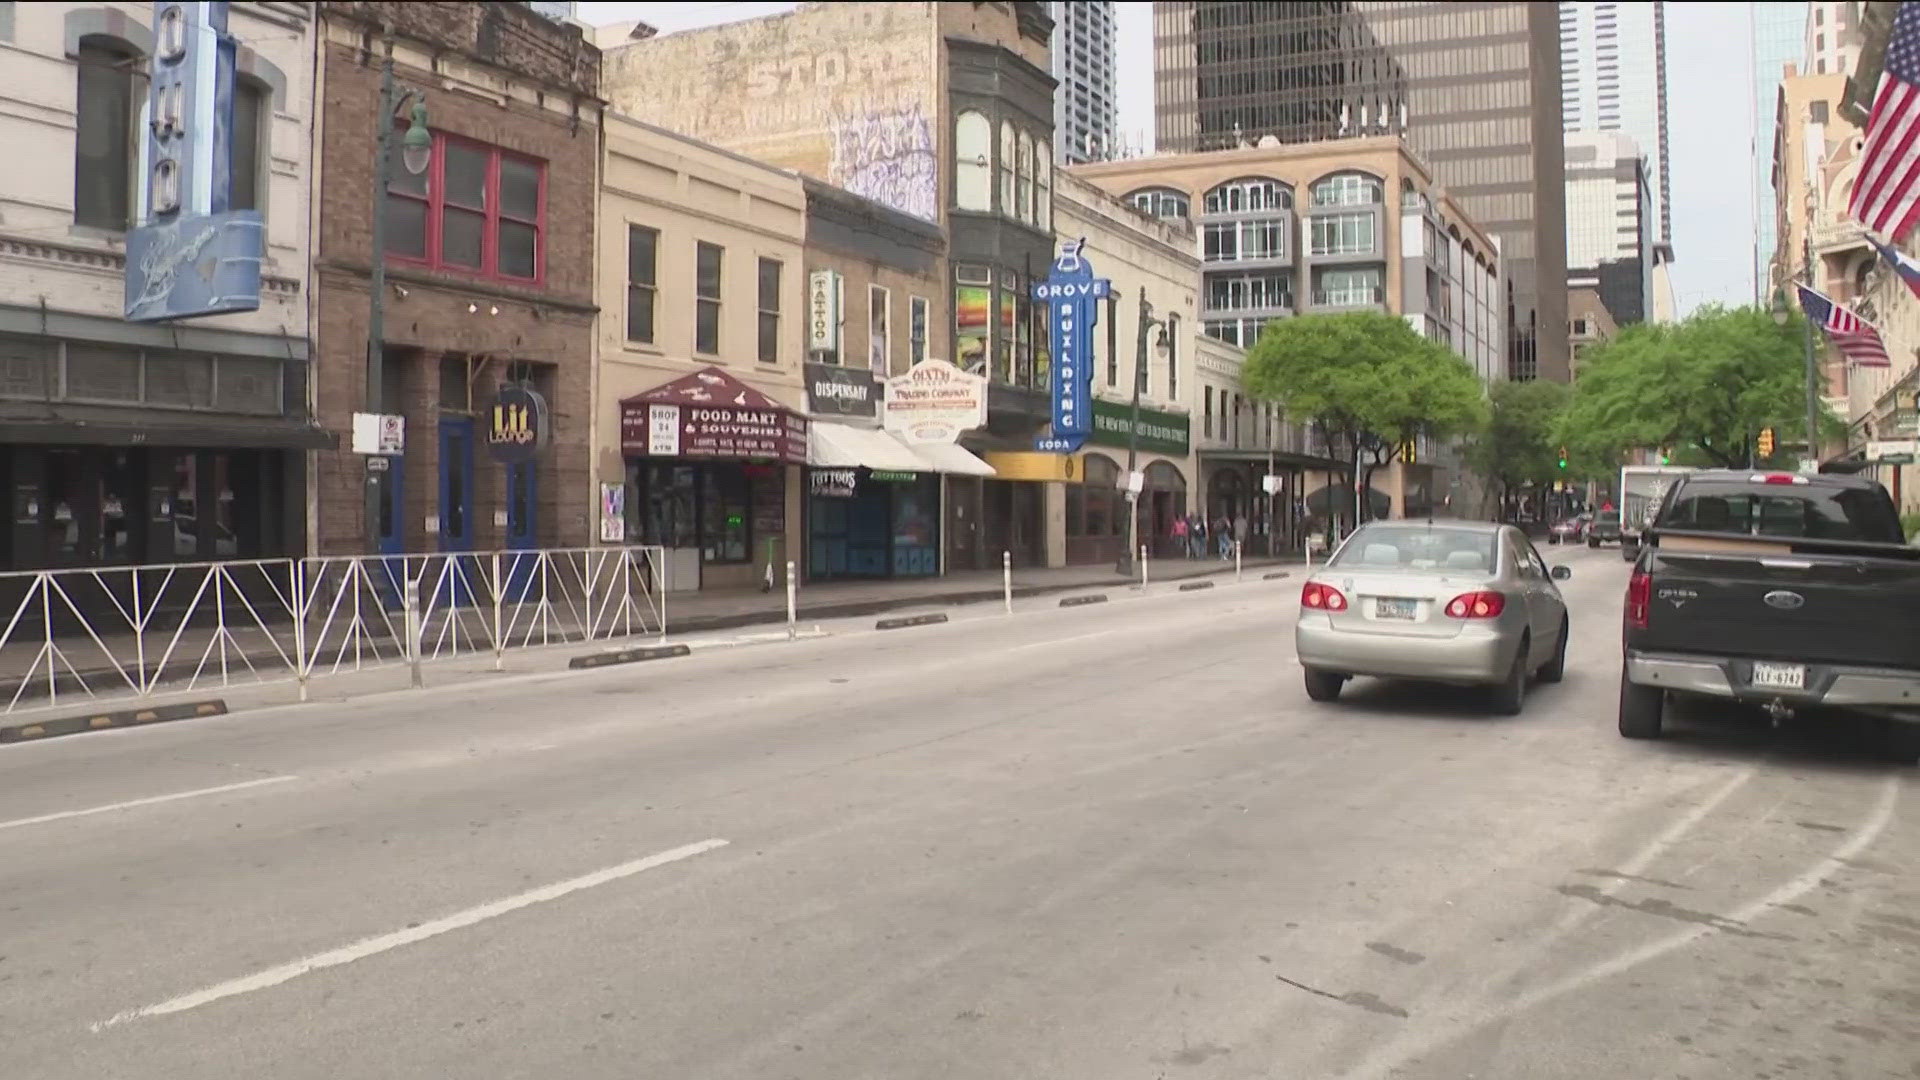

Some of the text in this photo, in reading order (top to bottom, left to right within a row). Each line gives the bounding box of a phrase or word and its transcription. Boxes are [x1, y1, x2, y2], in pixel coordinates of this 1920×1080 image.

[1036, 283, 1102, 299] GROVE
[814, 279, 826, 339] TATTOO
[1060, 303, 1074, 427] BUILDING
[815, 380, 868, 401] DISPENSARY
[651, 409, 677, 420] SHOP
[691, 409, 778, 425] FOOD MART
[488, 426, 534, 445] Lounge
[700, 423, 783, 437] SOUVENIRS
[1039, 439, 1070, 450] SODA
